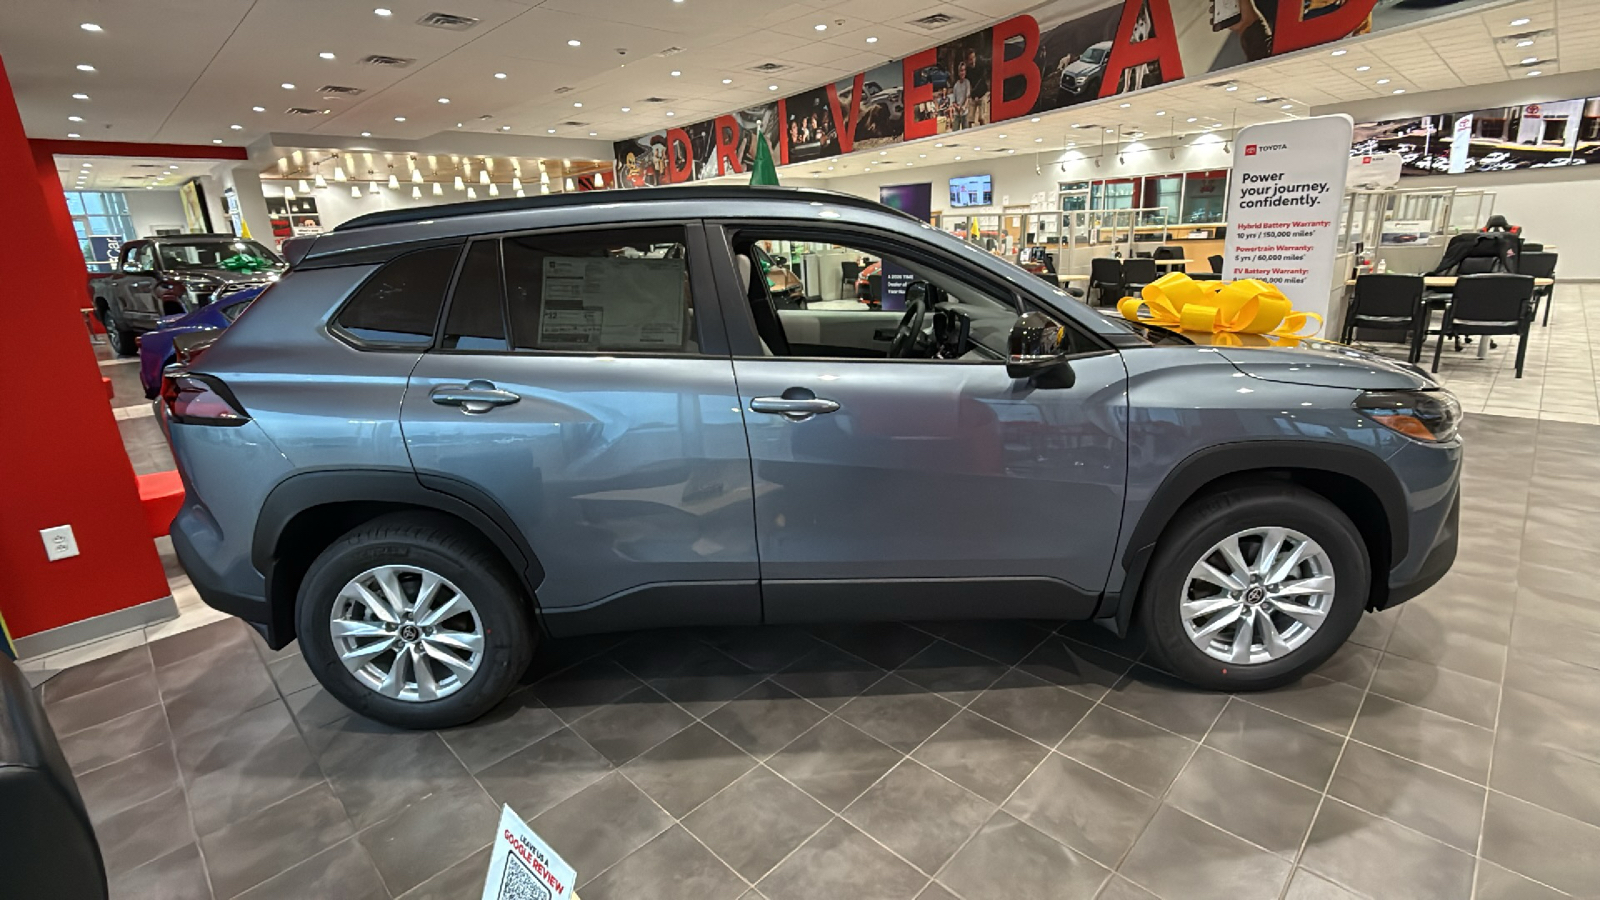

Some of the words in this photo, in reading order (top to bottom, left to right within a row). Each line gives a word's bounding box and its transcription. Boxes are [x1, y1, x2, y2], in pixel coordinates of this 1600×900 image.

[1259, 144, 1287, 152] TOYOTA
[1242, 172, 1285, 184] Power
[1240, 186, 1272, 199] your
[1272, 182, 1330, 197] journey,
[1239, 193, 1321, 209] confidently.
[1237, 223, 1262, 231] Hybrid
[1263, 230, 1291, 239] 150,000
[1257, 254, 1282, 262] 60,000
[520, 834, 537, 855] LEAVE
[536, 850, 544, 862] US
[544, 859, 549, 868] A
[504, 829, 532, 864] GOOGLE
[532, 858, 564, 895] REVIEW
